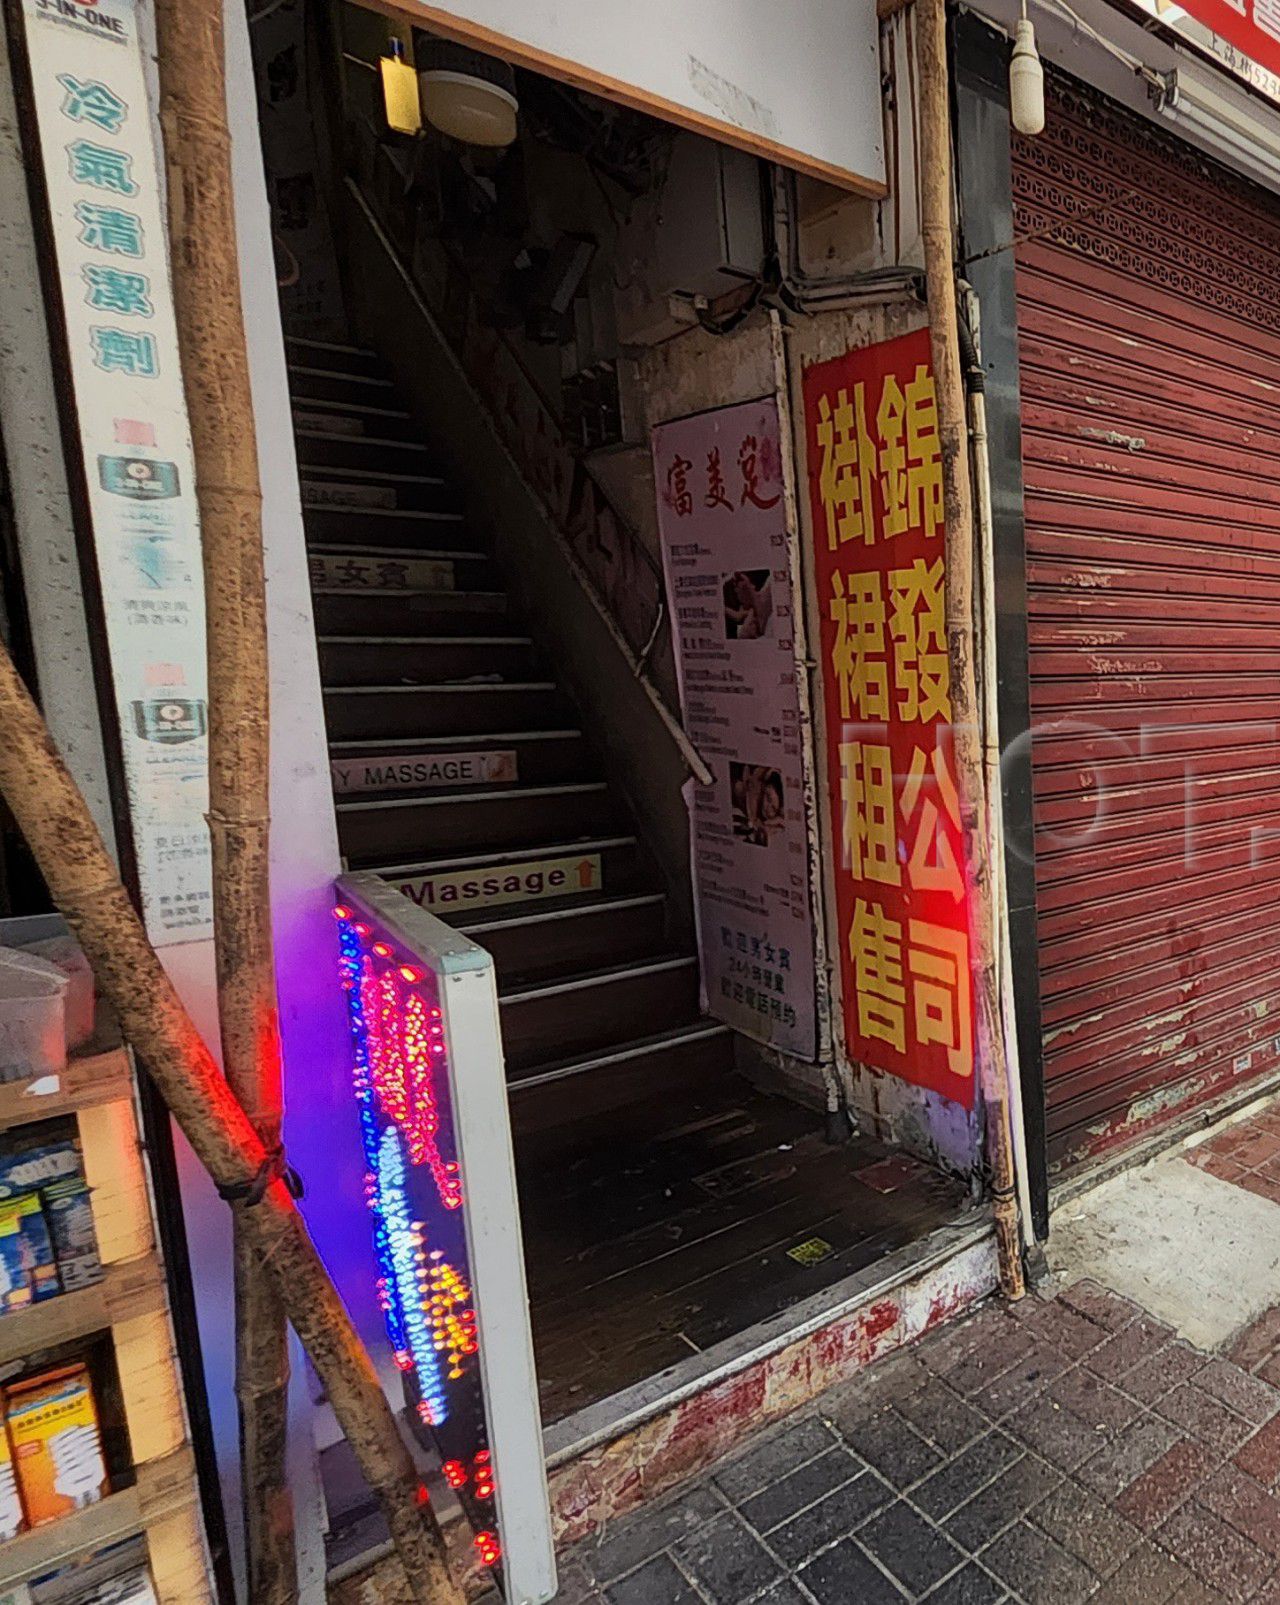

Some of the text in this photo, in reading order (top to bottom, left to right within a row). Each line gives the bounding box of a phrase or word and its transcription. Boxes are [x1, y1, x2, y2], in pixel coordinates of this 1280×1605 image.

[877, 364, 974, 1077] 錦發公司
[365, 760, 473, 785] MASSAGE
[401, 867, 565, 906] Massage
